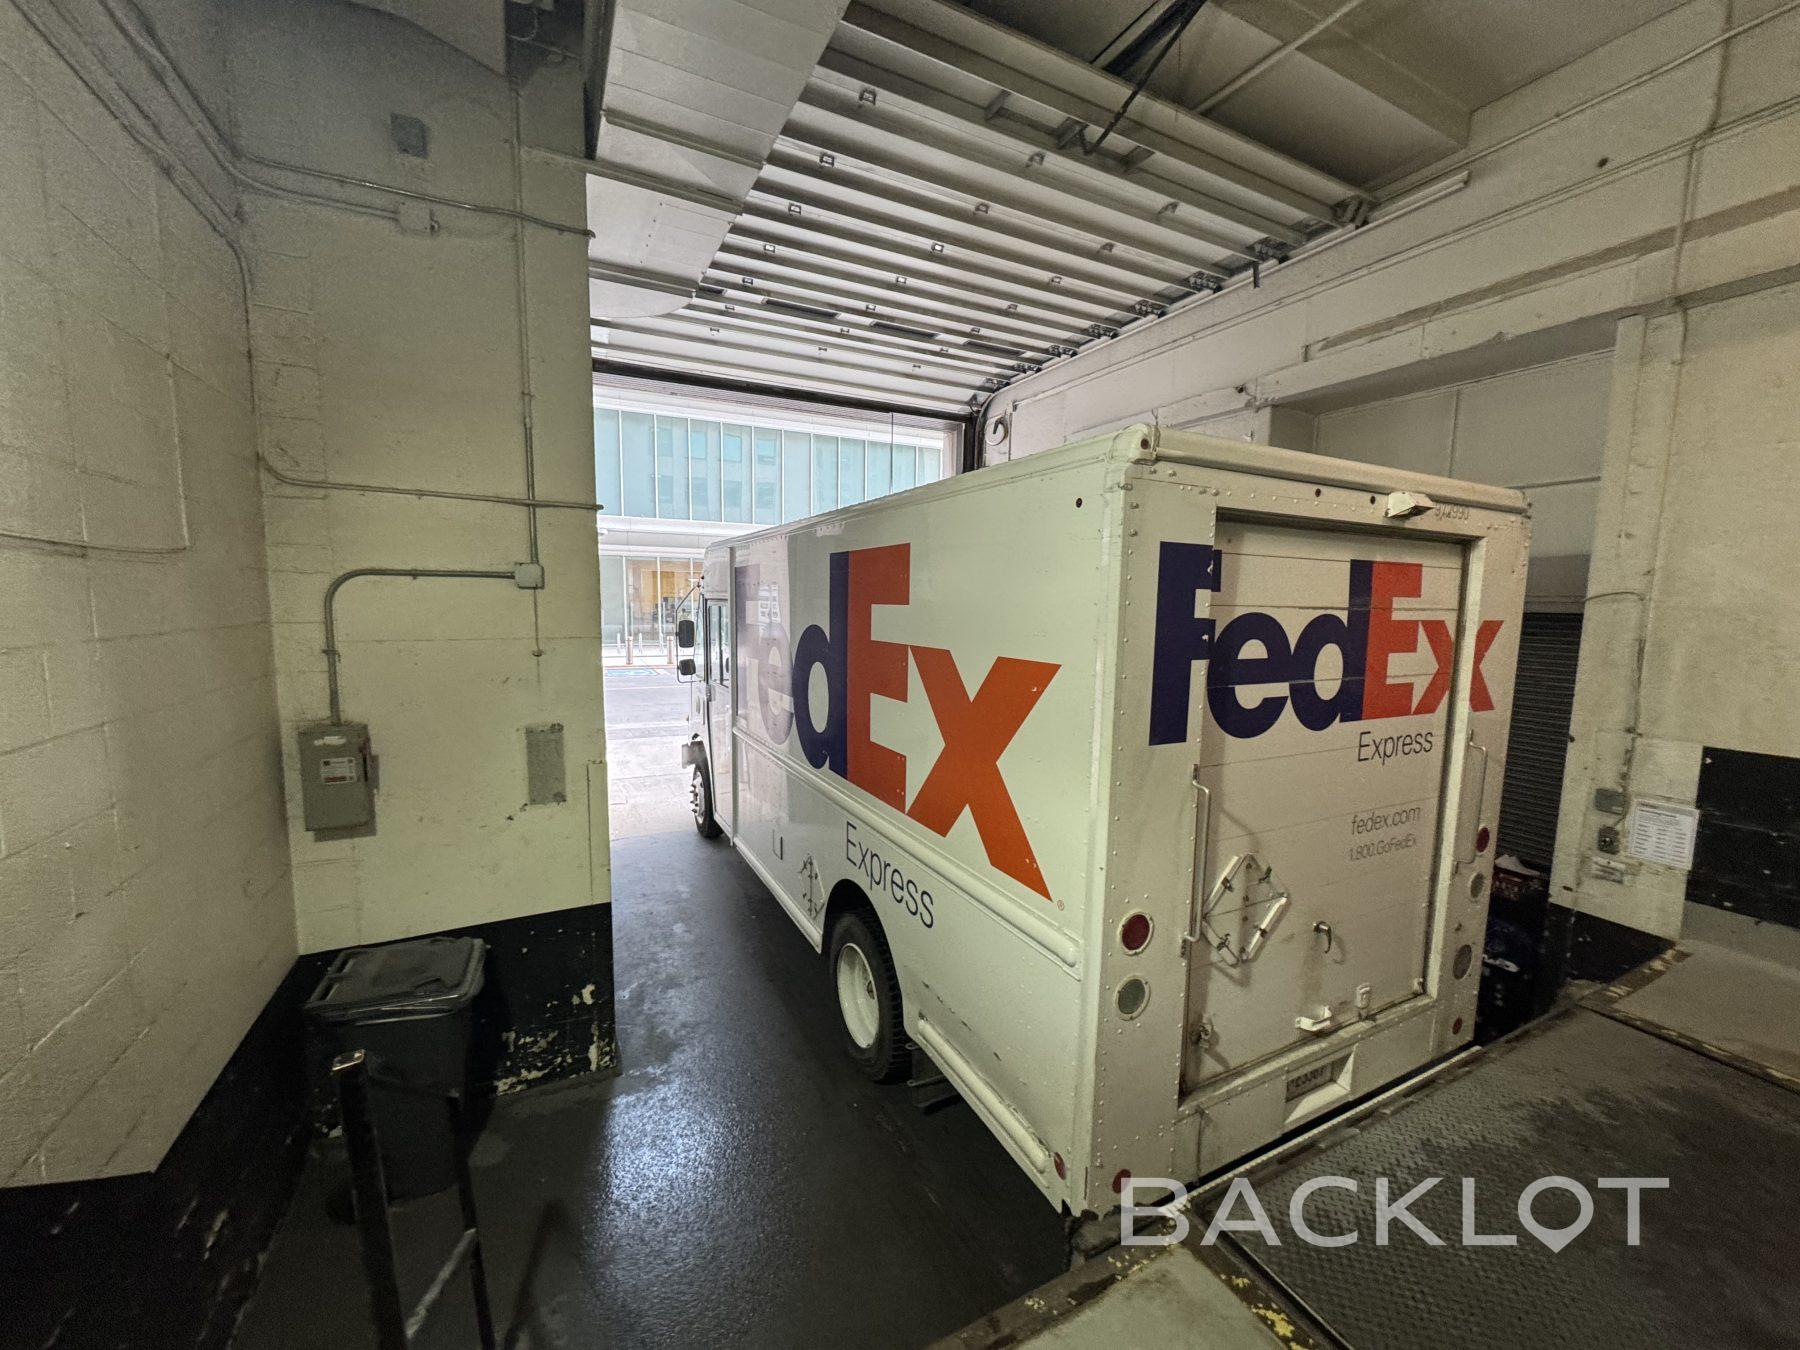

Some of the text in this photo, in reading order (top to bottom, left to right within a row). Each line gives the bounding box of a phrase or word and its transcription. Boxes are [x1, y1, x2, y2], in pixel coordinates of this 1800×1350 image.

[1149, 541, 1504, 746] FedEx
[736, 543, 1062, 902] FedEx
[1357, 730, 1434, 766] Express
[846, 821, 934, 929] Express
[1351, 807, 1421, 835] fedex.com
